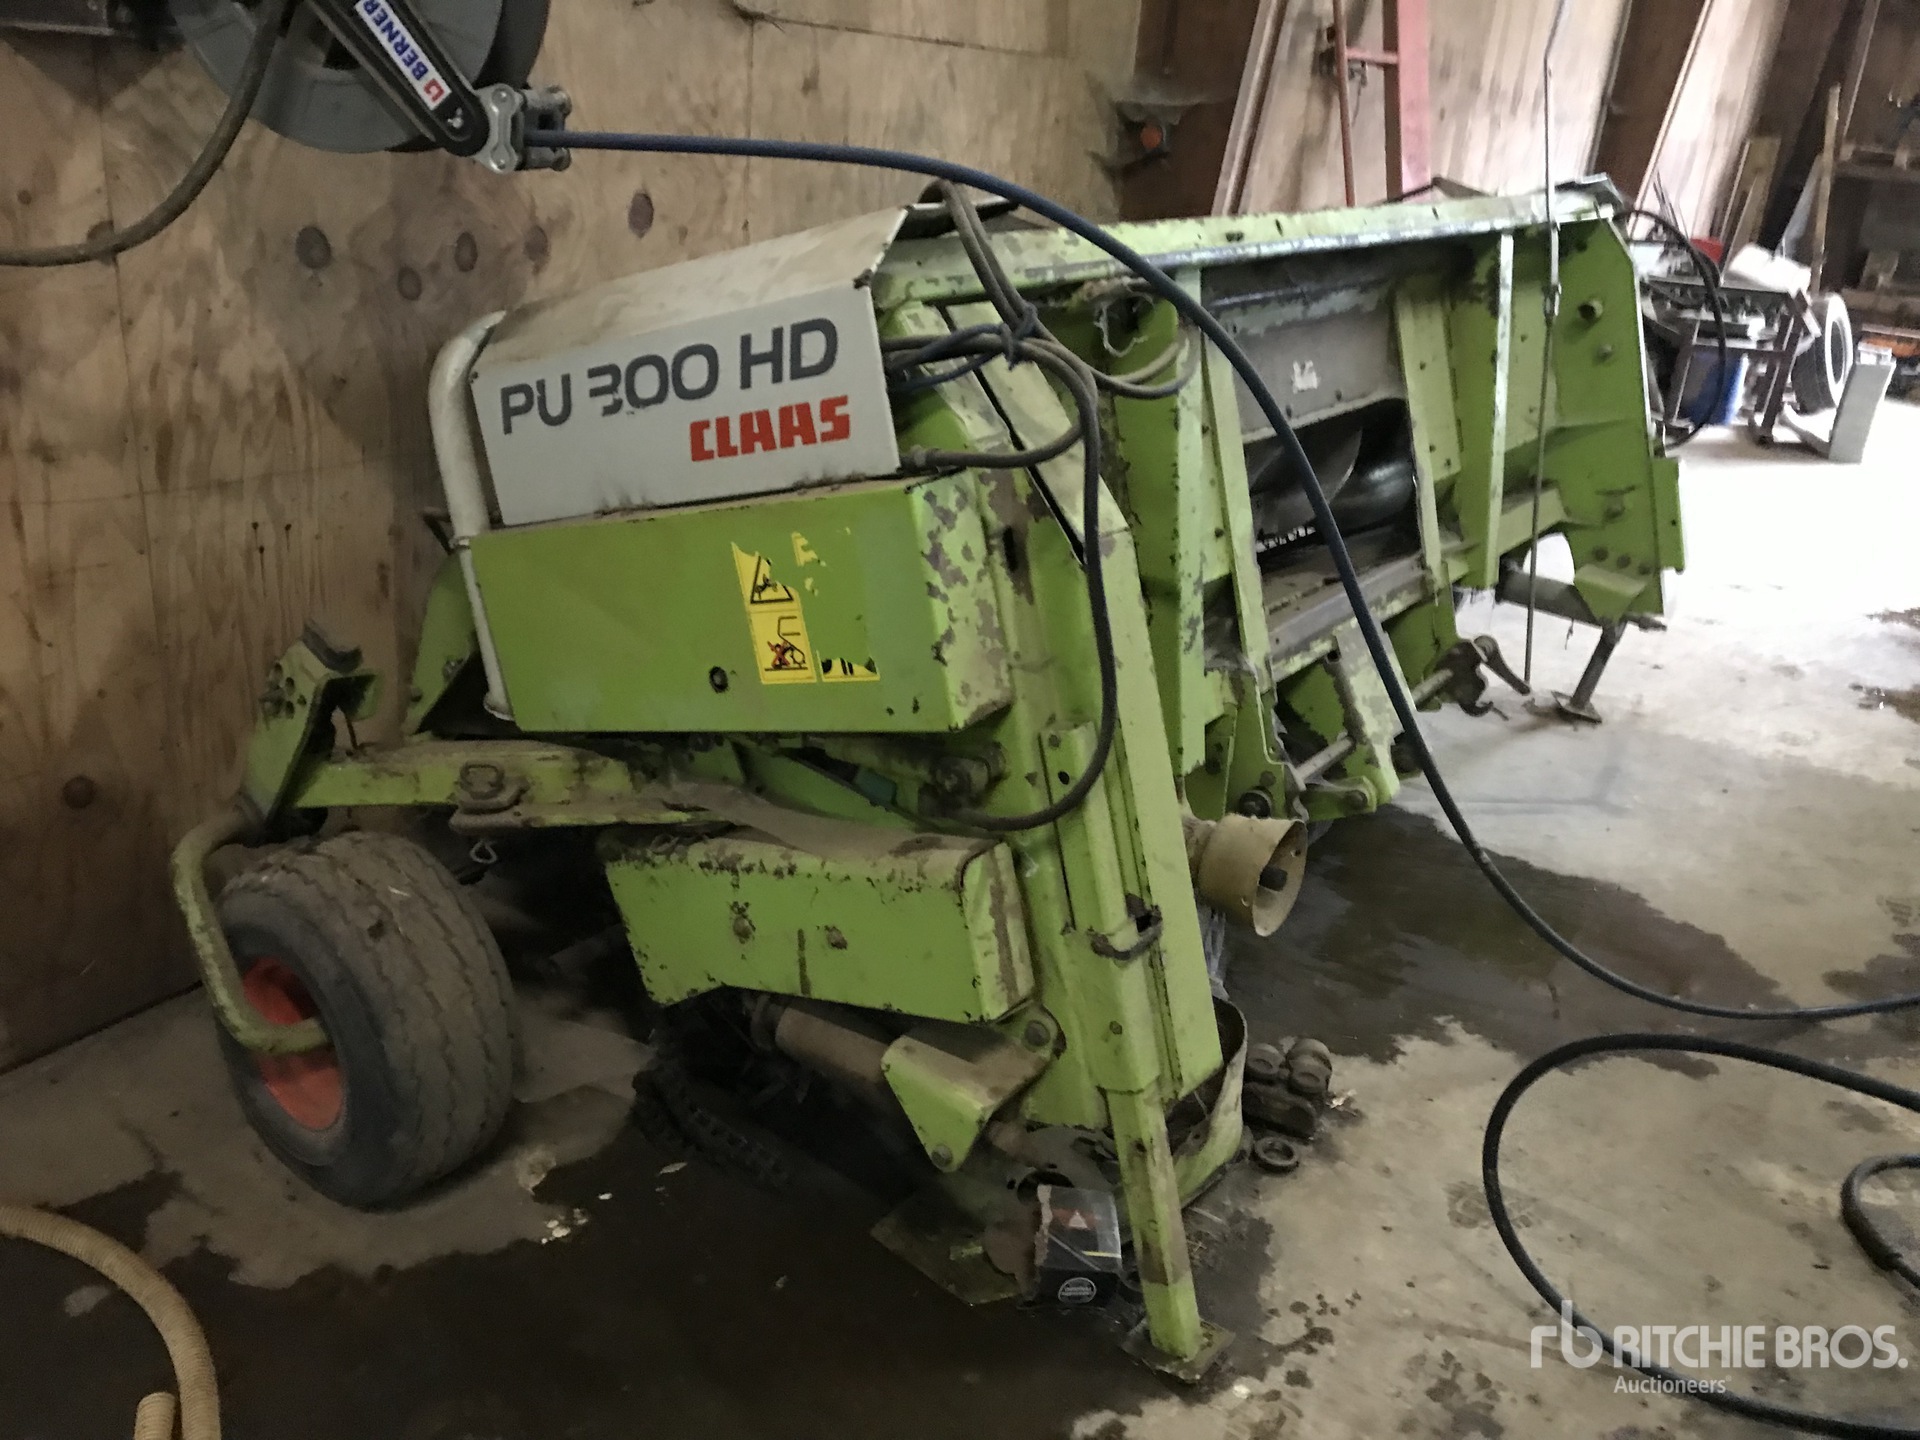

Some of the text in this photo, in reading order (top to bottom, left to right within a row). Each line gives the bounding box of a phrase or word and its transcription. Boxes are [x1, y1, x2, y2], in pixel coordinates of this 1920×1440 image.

[363, 0, 429, 80] BERNER
[500, 317, 839, 435] PU 300 HD
[689, 395, 851, 462] CLAAS
